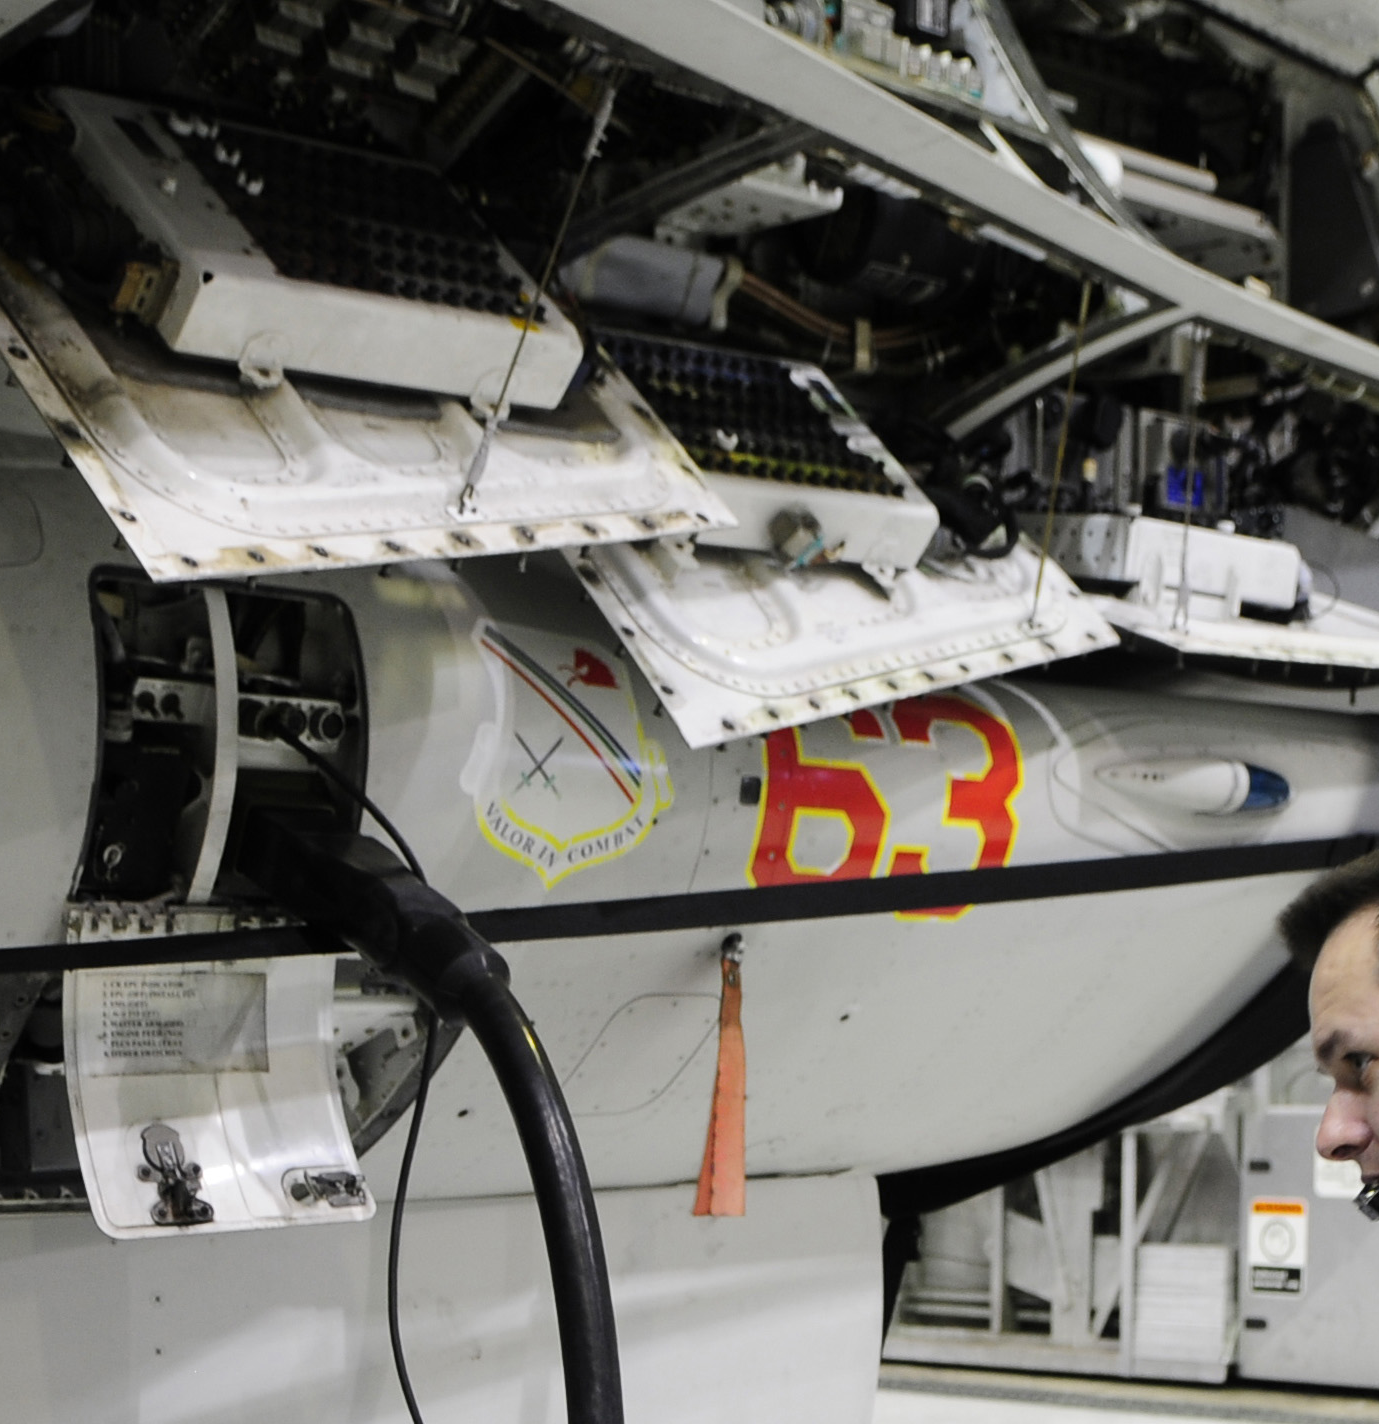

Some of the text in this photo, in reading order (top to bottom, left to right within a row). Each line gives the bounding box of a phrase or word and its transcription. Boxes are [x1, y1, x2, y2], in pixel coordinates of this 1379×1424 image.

[487, 801, 644, 868] VALOR IN COMBAT
[745, 690, 1024, 922] 63
